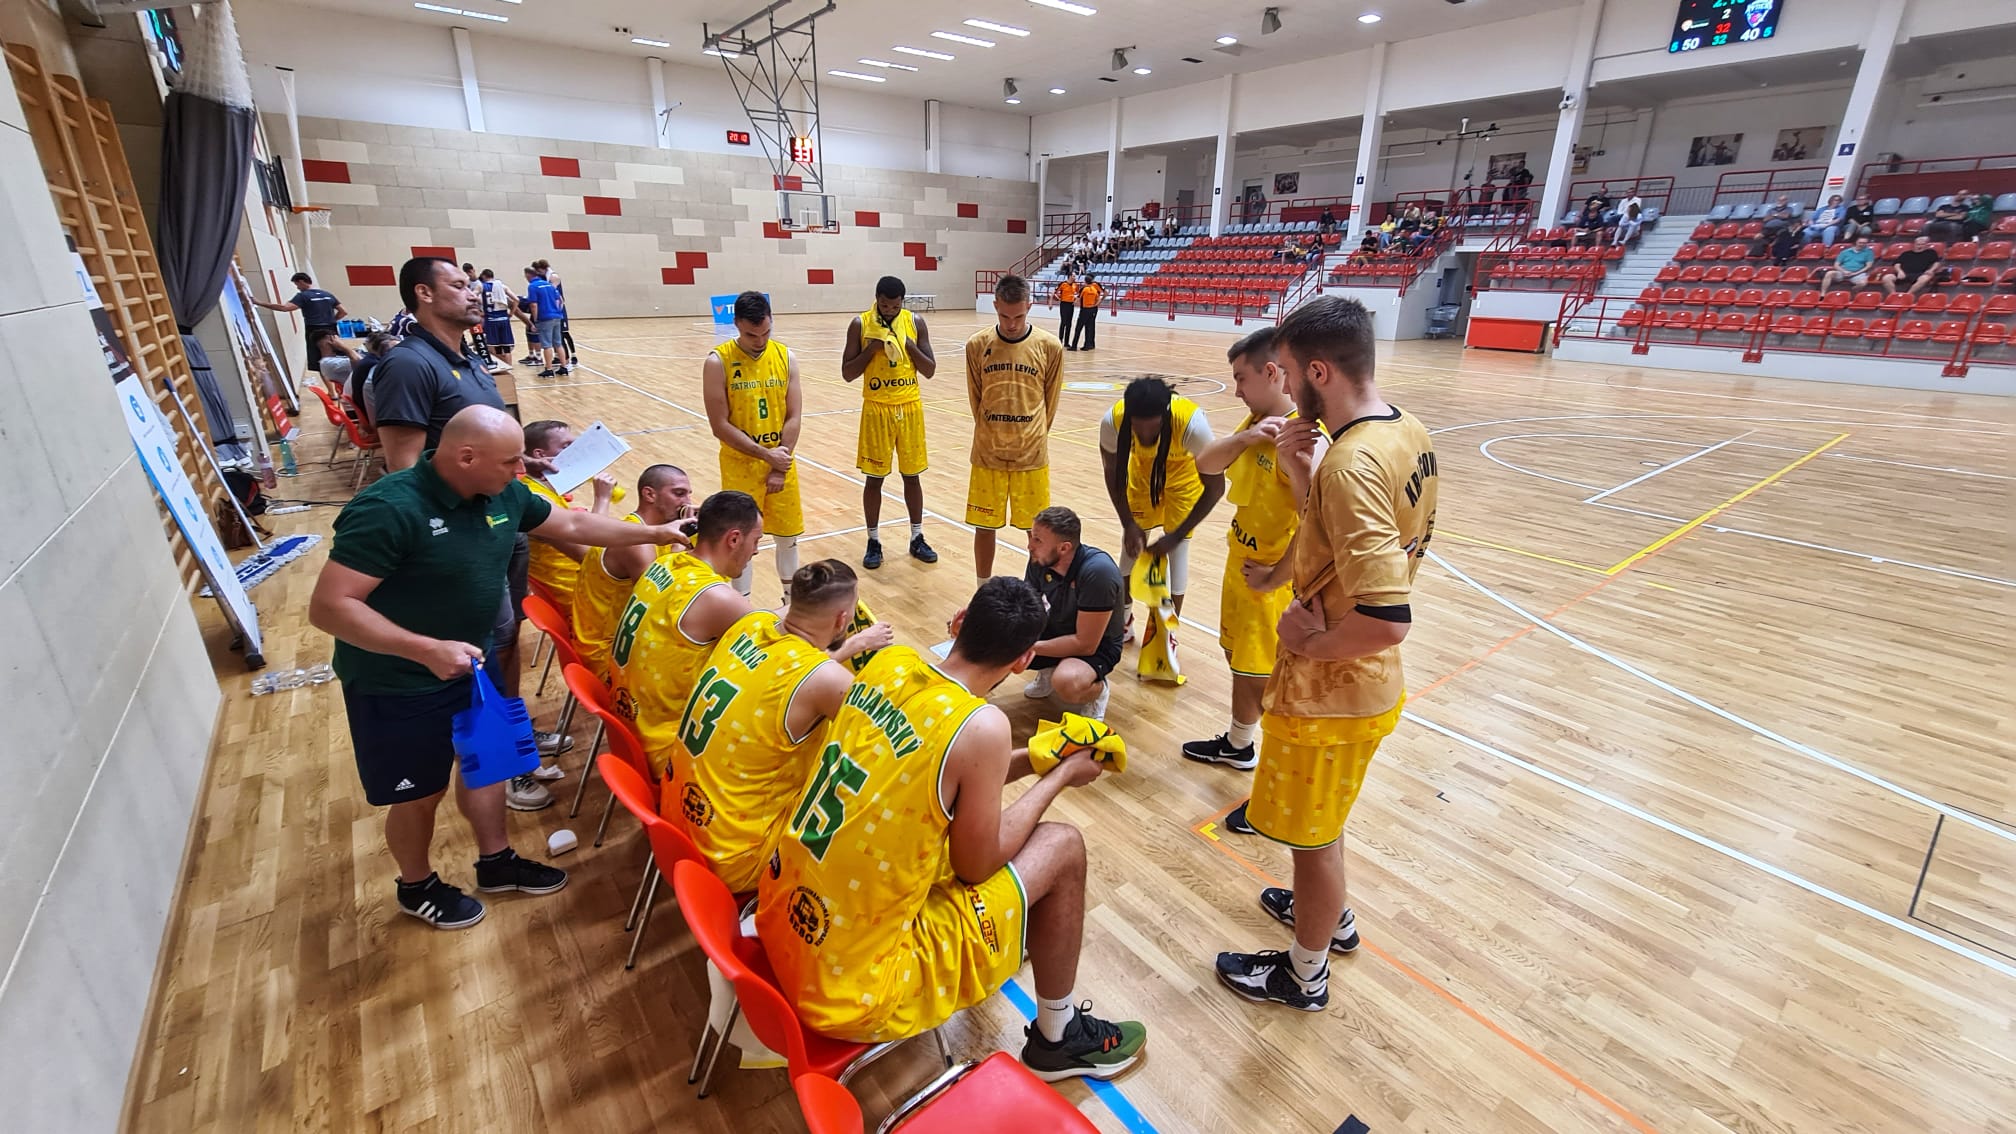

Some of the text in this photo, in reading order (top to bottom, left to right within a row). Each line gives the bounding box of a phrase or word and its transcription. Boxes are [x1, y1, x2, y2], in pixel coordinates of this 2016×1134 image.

[1722, 8, 1731, 19] 2
[1670, 27, 1773, 52] 5 50 32 40 5
[882, 377, 918, 387] VEOLIA
[758, 398, 769, 419] 8
[611, 593, 648, 669] 18
[678, 665, 741, 759] 13
[790, 740, 871, 864] 15
